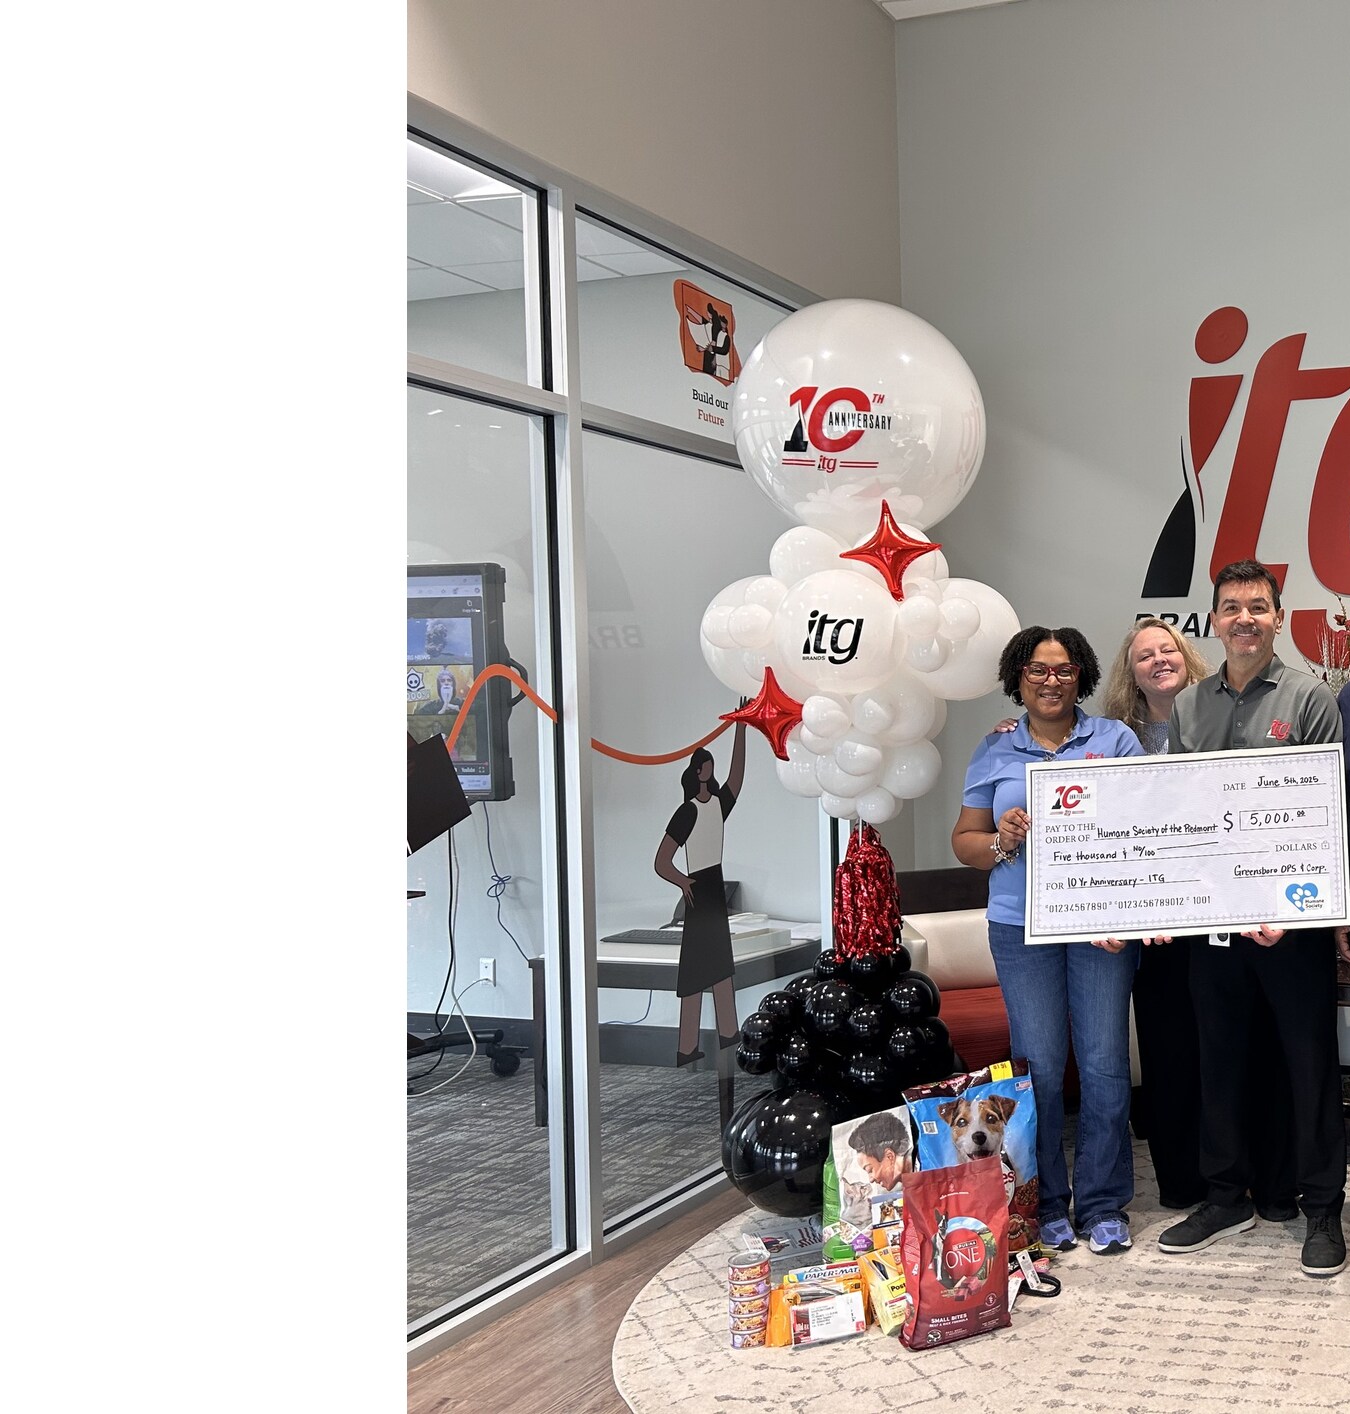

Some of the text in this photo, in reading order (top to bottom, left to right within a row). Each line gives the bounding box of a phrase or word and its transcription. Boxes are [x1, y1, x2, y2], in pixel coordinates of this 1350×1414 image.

[692, 389, 729, 411] Build our
[697, 409, 725, 427] Future
[784, 387, 886, 453] 10 TH
[829, 411, 892, 430] ANNIVERSARY
[817, 455, 837, 473] itg
[802, 610, 864, 664] itg
[1223, 783, 1246, 792] DATE
[1257, 776, 1281, 788] June
[1300, 775, 1319, 784] 2025
[1051, 785, 1084, 810] 10
[1045, 823, 1096, 833] PAY TO THE
[1223, 810, 1234, 833] $
[1097, 823, 1219, 839] Humane Society of the Piedmont
[1045, 834, 1091, 844] ORDER OF
[1275, 843, 1318, 852] DOLLARS
[1053, 850, 1072, 862] Five
[1075, 850, 1117, 861] thousand
[1234, 864, 1278, 876] Greensboro
[1280, 864, 1297, 873] OPS
[1045, 882, 1064, 891] FOR
[1067, 877, 1077, 888] 10
[1078, 877, 1088, 887] Yr
[1090, 876, 1138, 888] Anniversary
[1148, 874, 1165, 883] ITG
[1192, 896, 1211, 905] 1001
[945, 1246, 981, 1269] ONE
[951, 1313, 968, 1321] BITES
